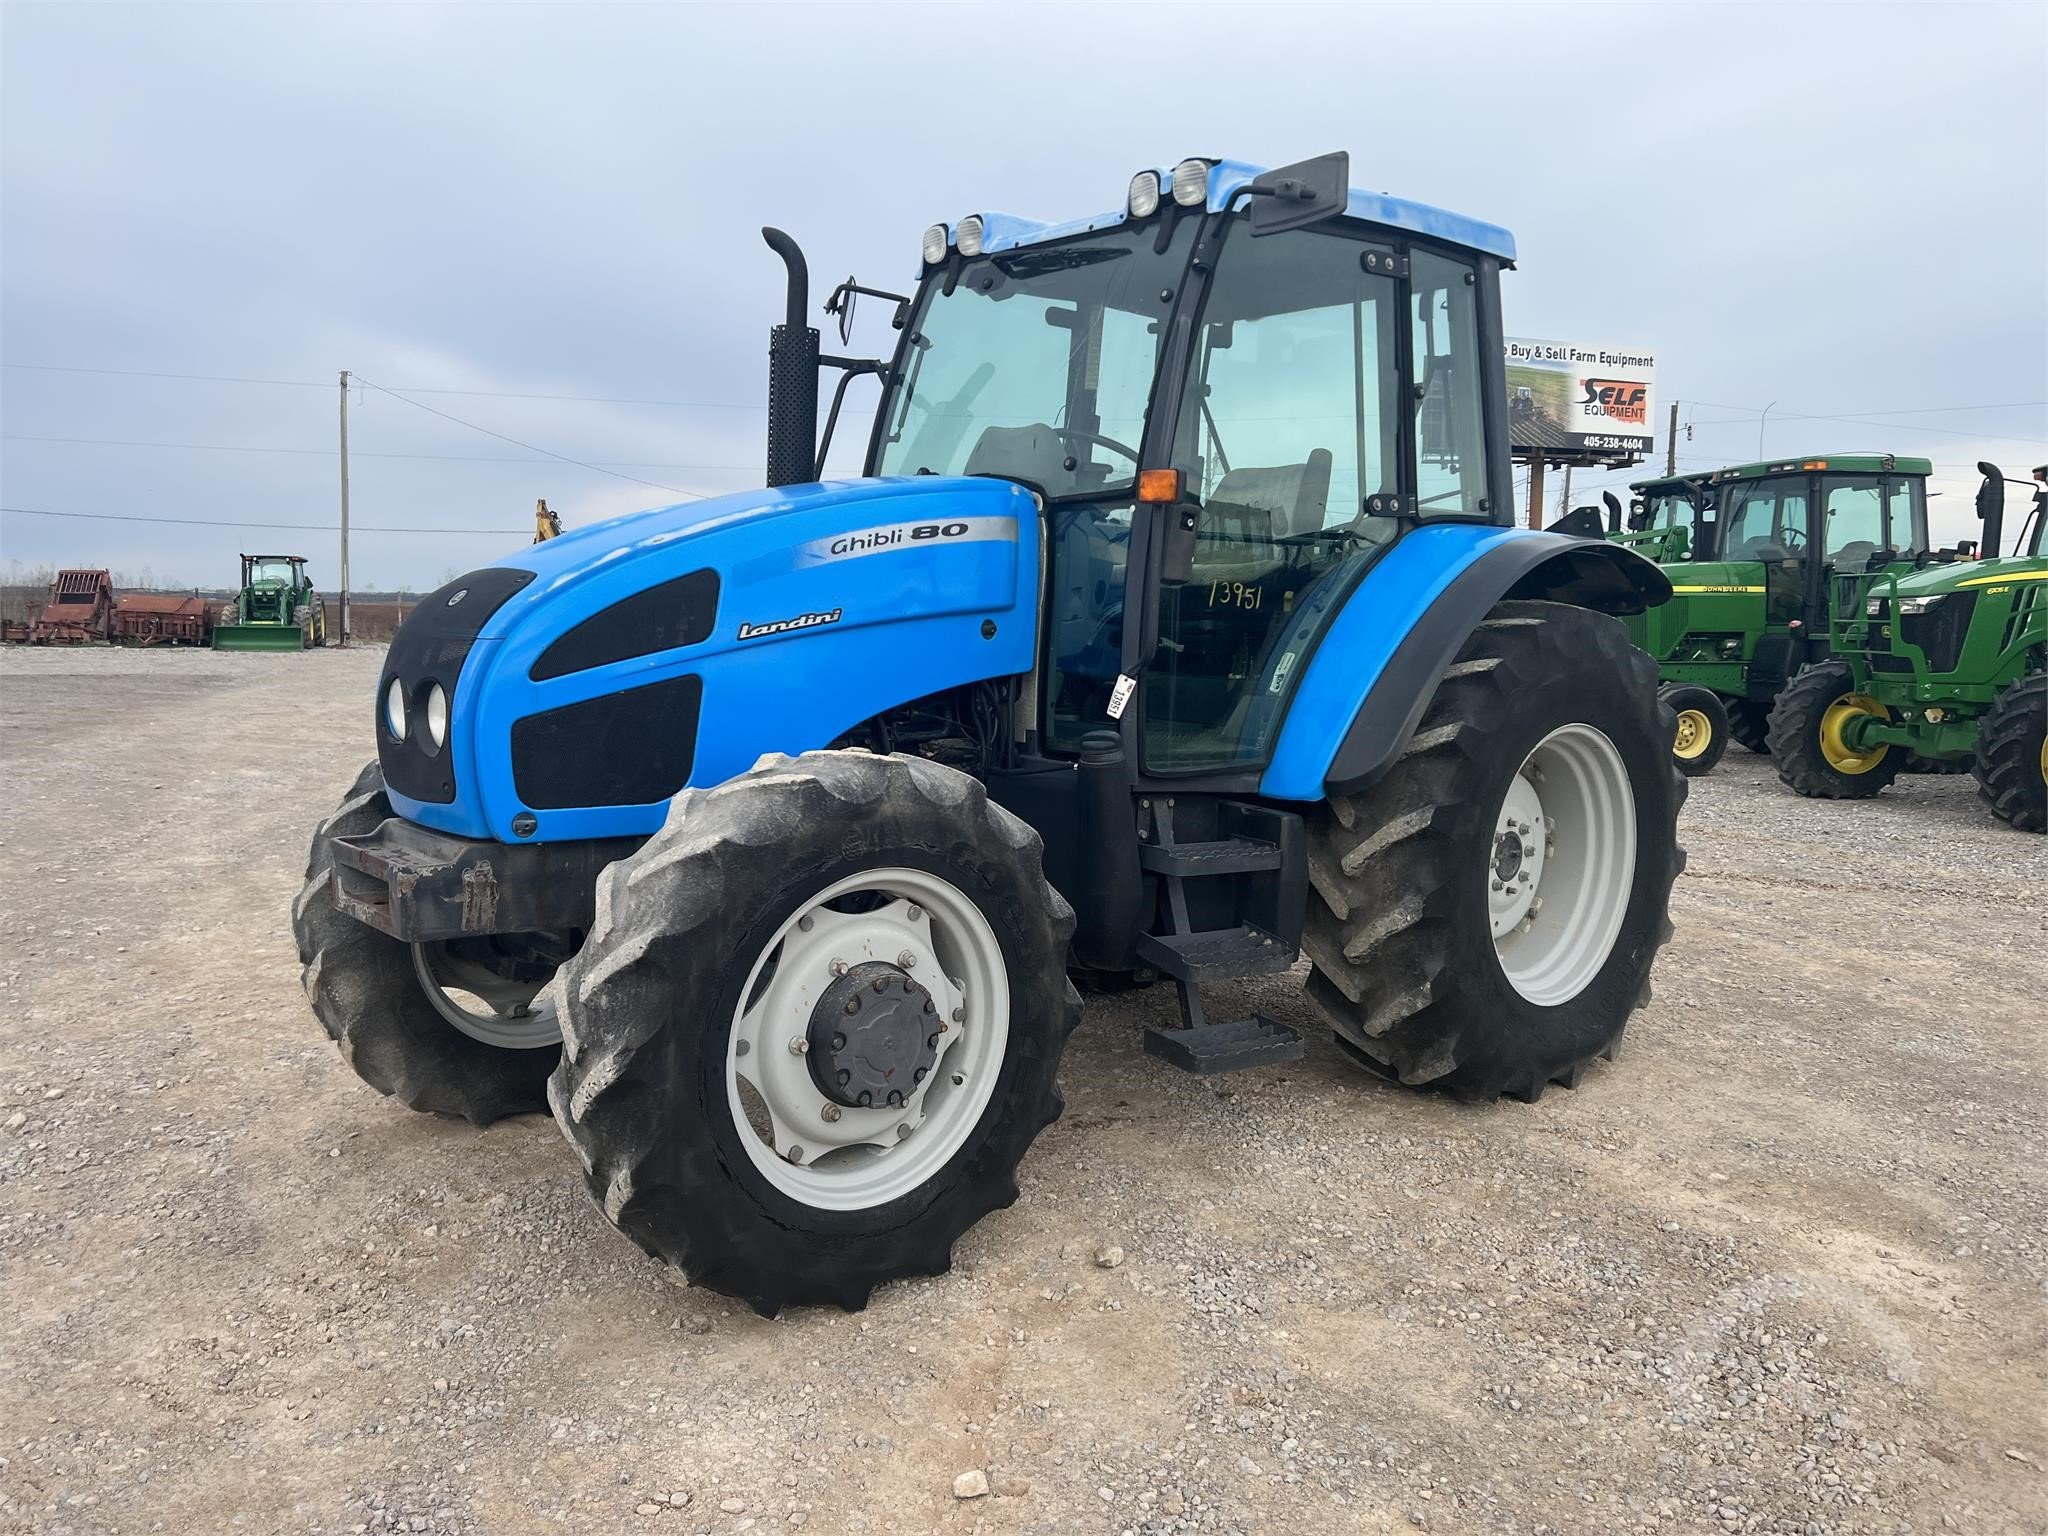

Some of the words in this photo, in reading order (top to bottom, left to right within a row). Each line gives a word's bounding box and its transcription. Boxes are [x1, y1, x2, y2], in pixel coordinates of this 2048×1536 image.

[1511, 344, 1531, 360] Buy
[1535, 346, 1542, 358] &
[1546, 347, 1567, 361] Sell
[1570, 349, 1596, 363] Farm
[1600, 352, 1654, 368] Equipment
[1576, 378, 1651, 406] SELF
[1584, 405, 1645, 418] EQUIPMENT
[1583, 436, 1643, 449] 405-238-4604
[830, 529, 902, 555] Ghibli
[910, 523, 969, 540] 80
[1209, 579, 1261, 609] 13951
[1109, 690, 1125, 714] 13951
